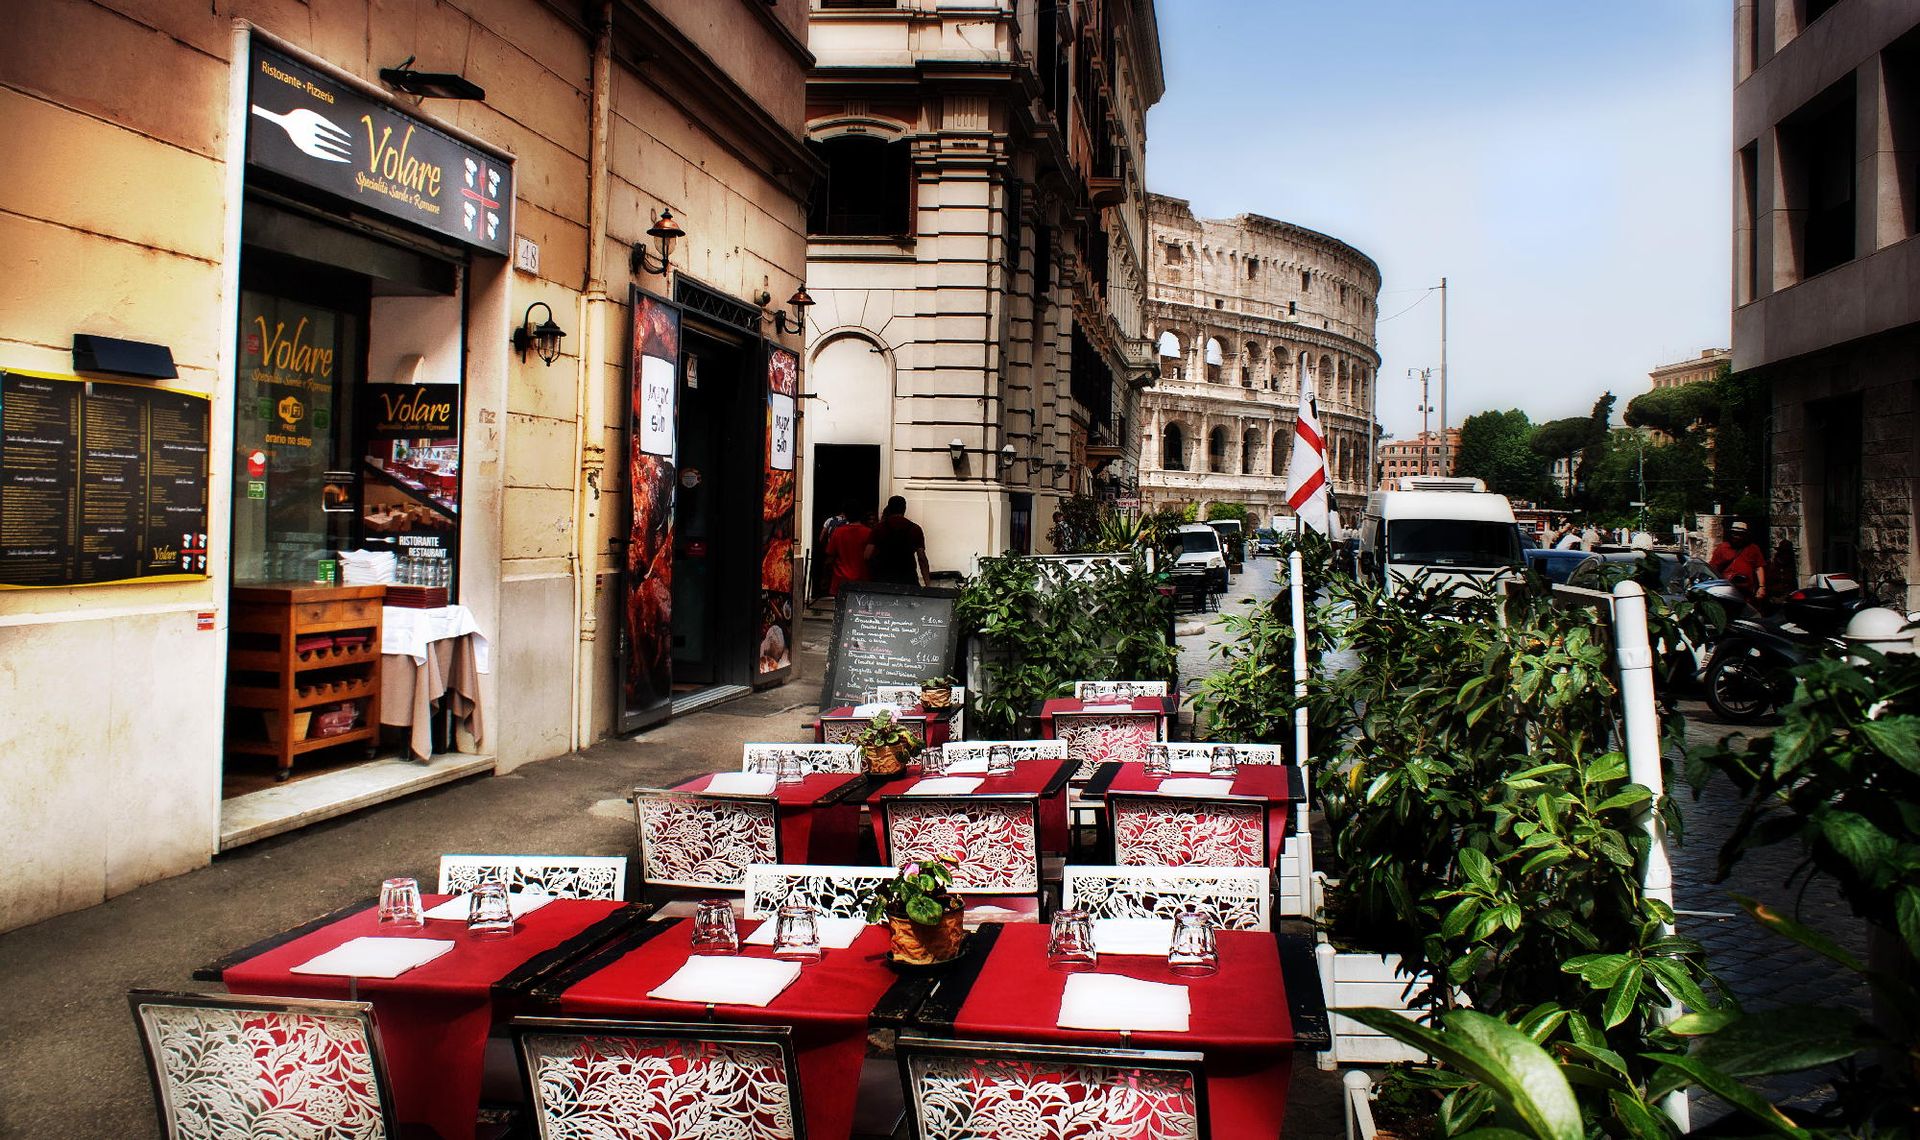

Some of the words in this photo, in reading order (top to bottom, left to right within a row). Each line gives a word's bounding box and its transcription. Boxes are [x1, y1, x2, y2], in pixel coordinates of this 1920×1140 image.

[262, 61, 301, 89] Ristorante
[306, 82, 335, 105] Pizzeria
[361, 114, 441, 197] Volare
[413, 193, 441, 215] Romane
[254, 314, 333, 377] Volare
[380, 387, 450, 422] Volare
[399, 535, 440, 547] RISTORANTE
[408, 547, 448, 559] RESTAURANT
